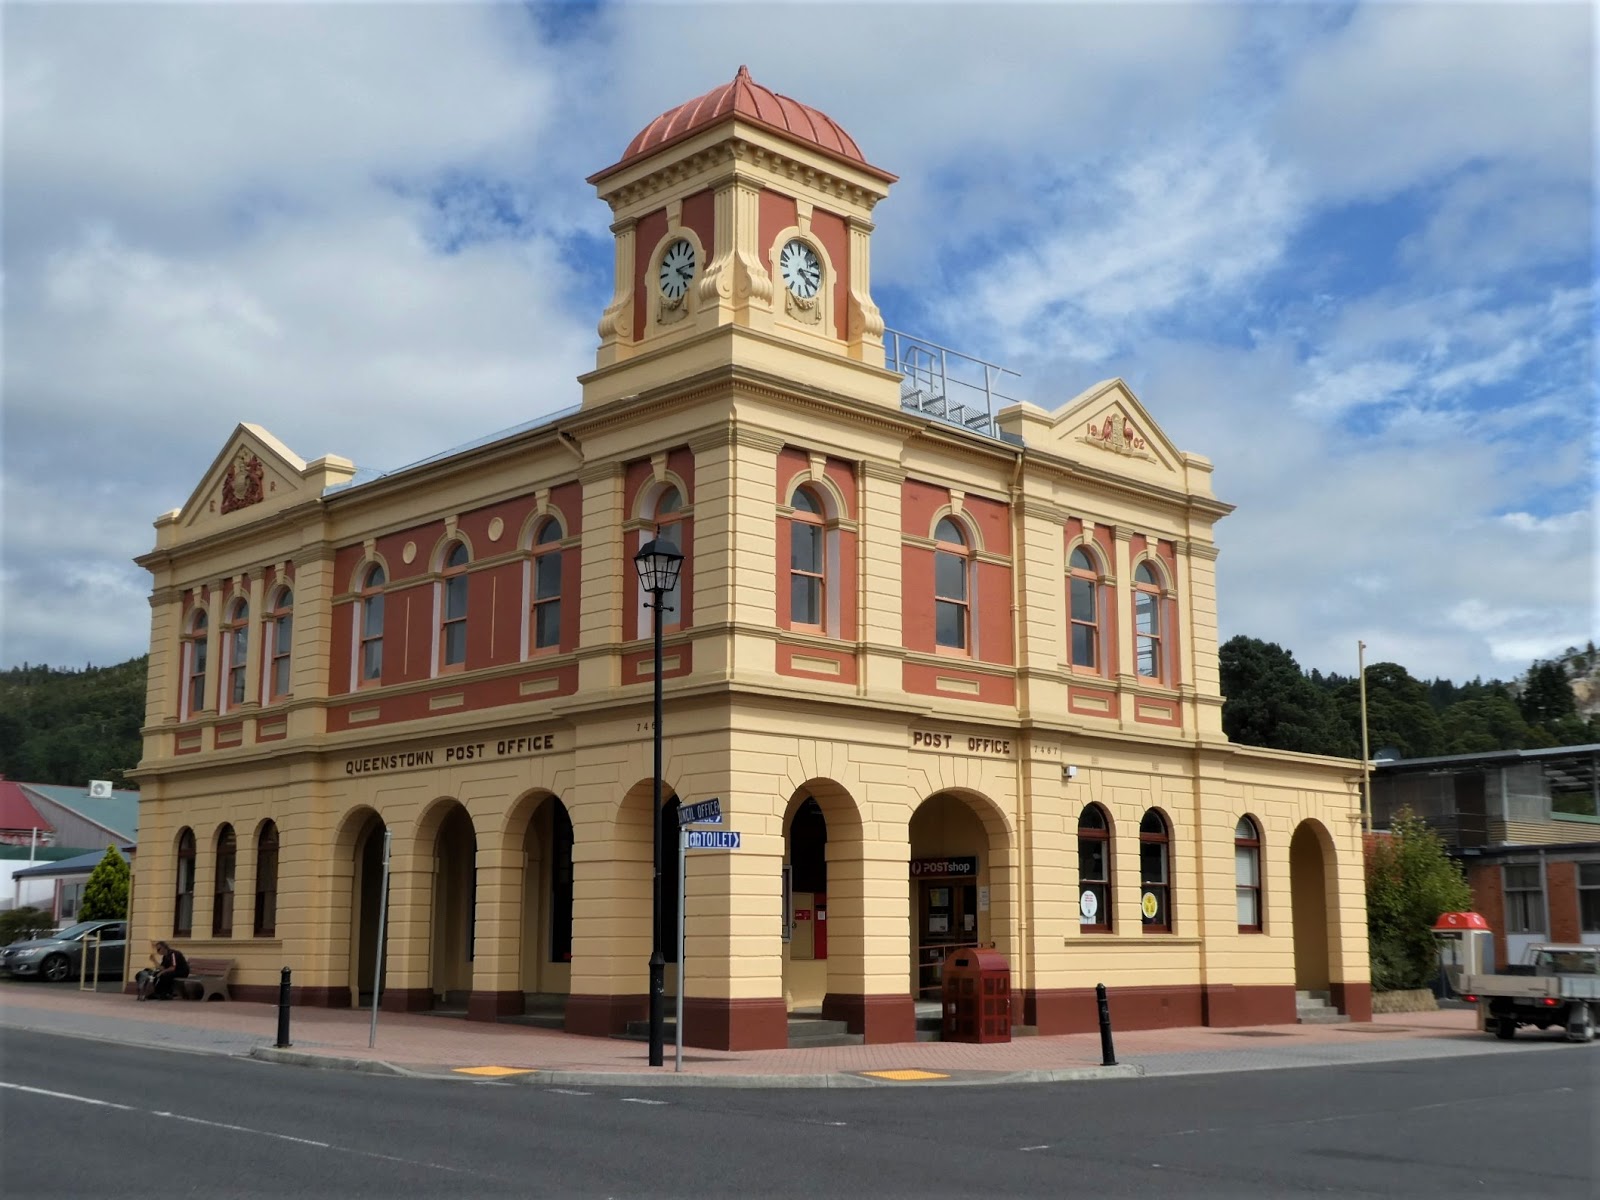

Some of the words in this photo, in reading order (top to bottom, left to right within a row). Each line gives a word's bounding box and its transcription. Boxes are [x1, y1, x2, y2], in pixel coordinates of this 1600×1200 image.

[913, 731, 952, 748] POST
[968, 737, 1010, 754] OFFICE
[346, 750, 434, 774] QUEENSTOWN
[446, 743, 485, 761] POST
[497, 735, 554, 755] OFFICE
[701, 832, 732, 847] TOILET
